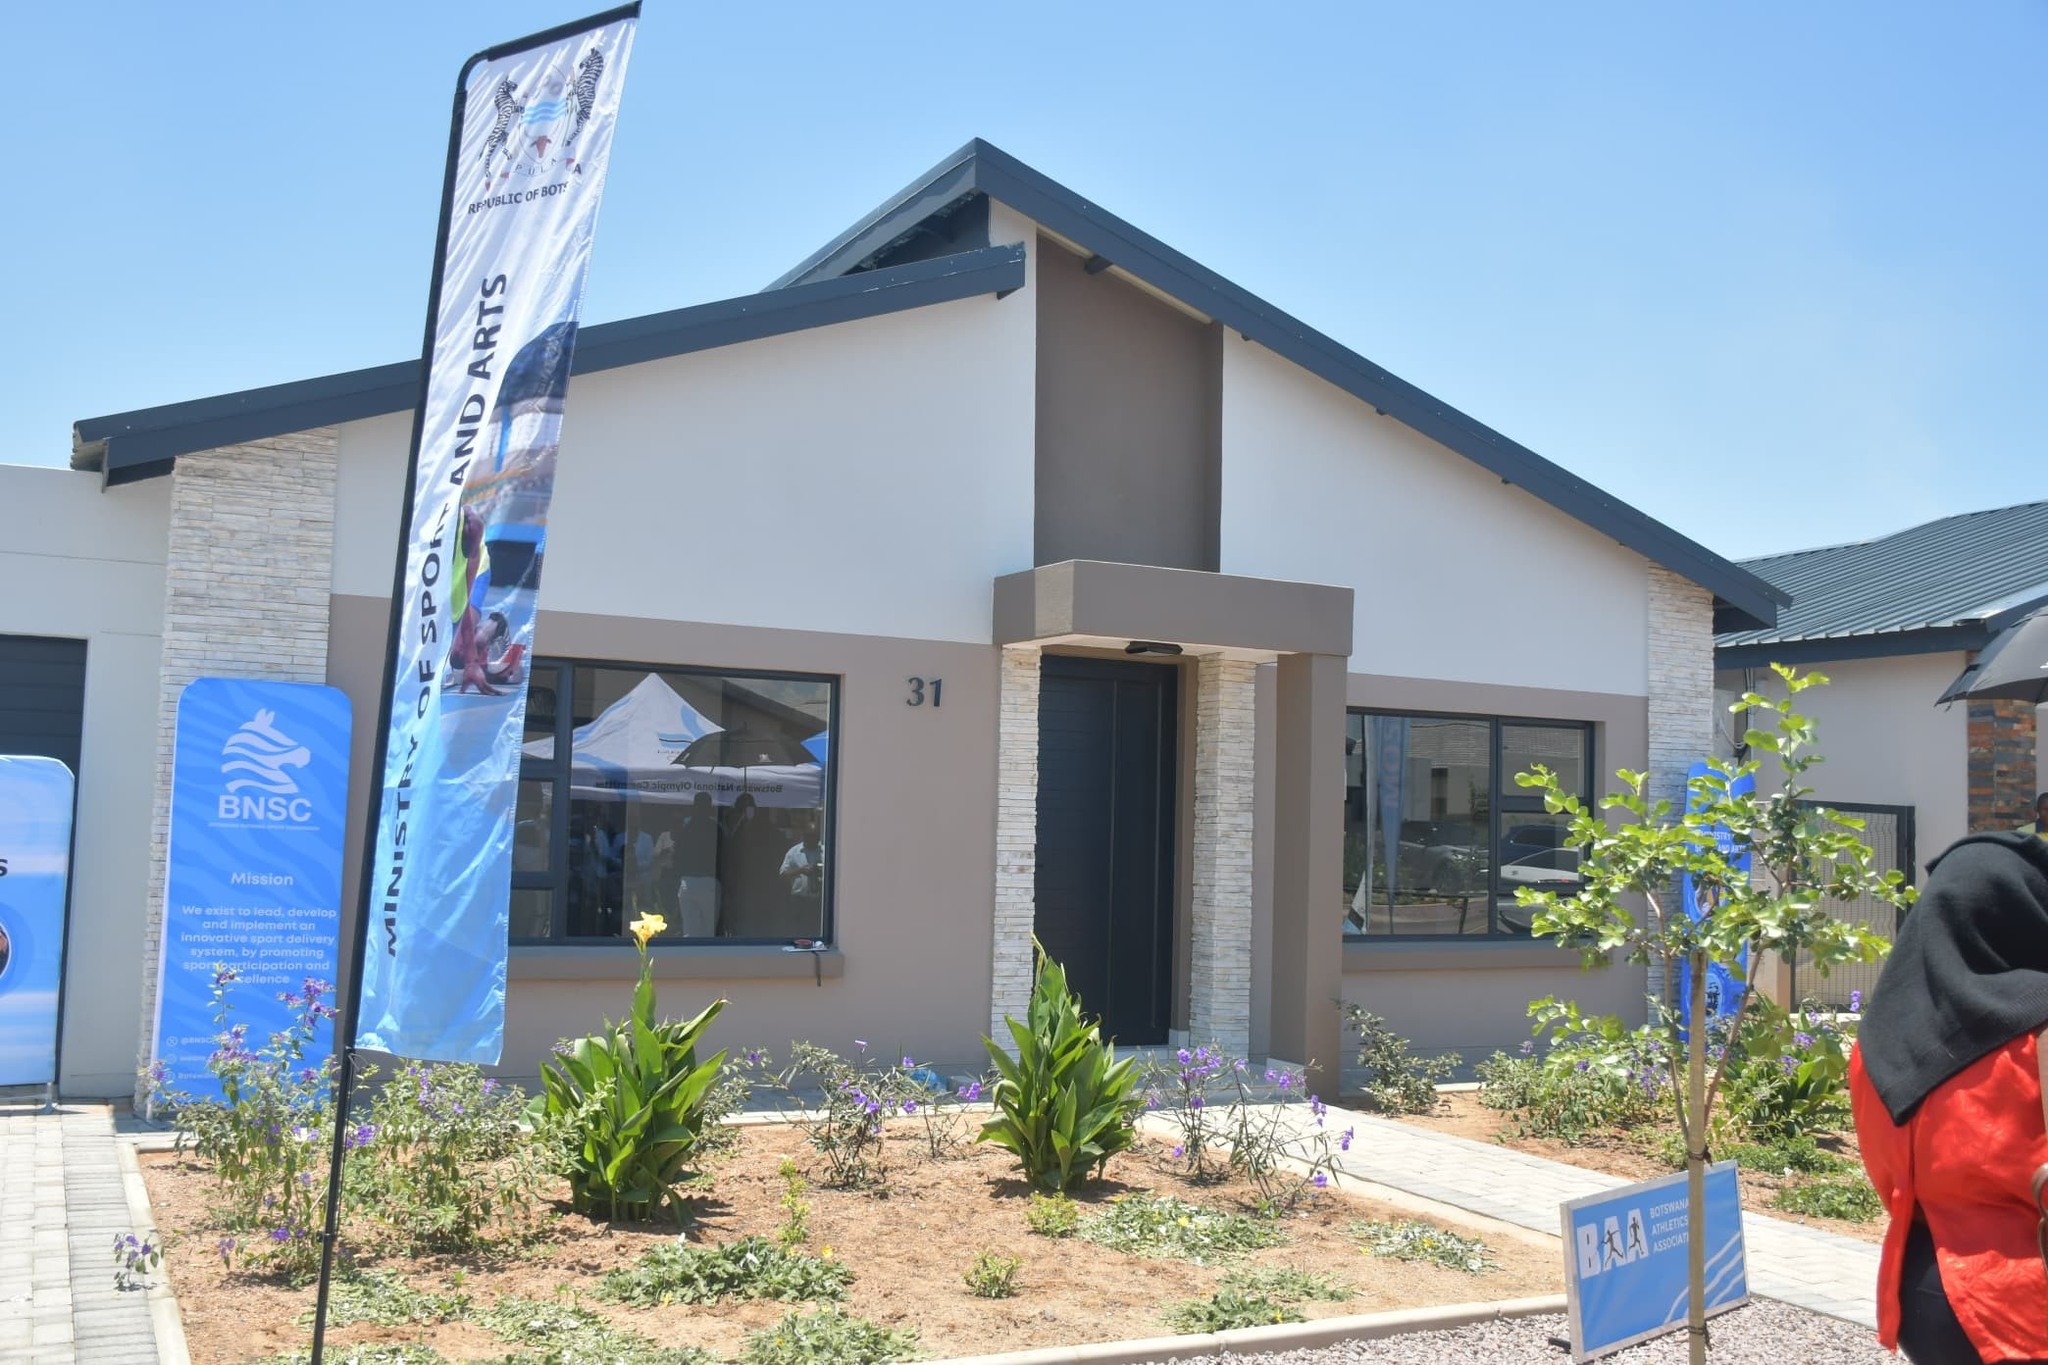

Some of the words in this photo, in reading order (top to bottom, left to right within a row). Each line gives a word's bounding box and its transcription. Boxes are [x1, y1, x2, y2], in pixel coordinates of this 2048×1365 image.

[525, 188, 540, 202] OF
[467, 273, 507, 380] ARTS
[450, 394, 486, 486] AND
[417, 660, 436, 719] OF
[906, 677, 943, 707] 31
[218, 794, 312, 822] BNSC
[231, 872, 294, 886] Mission
[182, 906, 201, 915] We
[205, 906, 236, 916] exist
[238, 907, 251, 916] to
[254, 907, 285, 918] lead,
[288, 907, 337, 919] develop
[203, 920, 227, 929] and
[231, 920, 296, 931] implement
[297, 923, 315, 931] an
[181, 932, 248, 943] innovative
[251, 935, 283, 945] sport
[286, 934, 335, 946] delivery
[190, 948, 238, 958] system,
[242, 948, 256, 959] by
[260, 949, 324, 960] promoting
[221, 960, 303, 973] participation
[305, 961, 330, 971] and
[1650, 1198, 1690, 1219] BOTSWANA
[1652, 1215, 1689, 1235] ATHLETICS
[1653, 1231, 1690, 1254] ASSOCIATI
